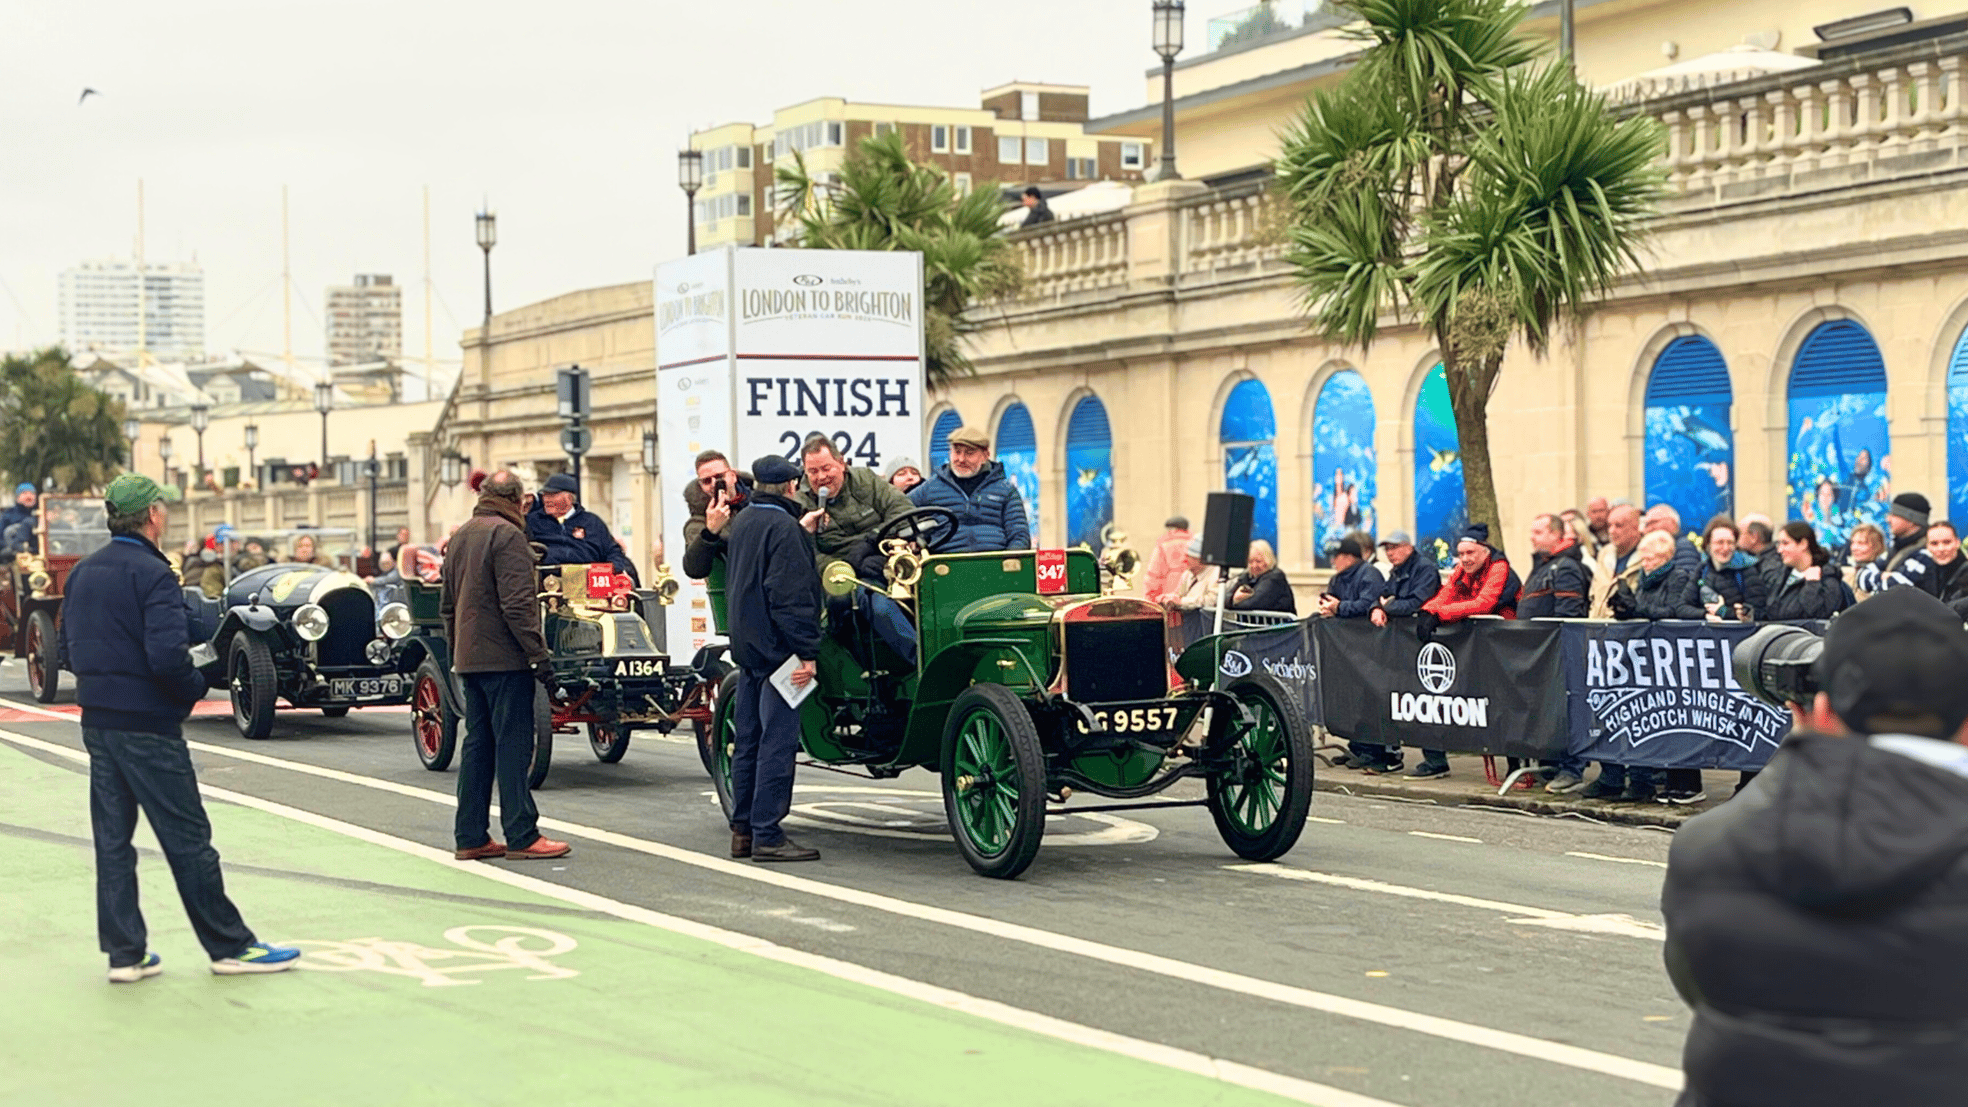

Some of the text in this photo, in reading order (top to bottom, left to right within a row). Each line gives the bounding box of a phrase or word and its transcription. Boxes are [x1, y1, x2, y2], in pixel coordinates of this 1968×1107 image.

[742, 289, 912, 321] LONDON TO BRIGHTON
[746, 377, 910, 417] FINISH
[779, 430, 881, 467] 224
[591, 575, 611, 588] 181
[1038, 564, 1065, 580] 347
[1262, 655, 1317, 684] Sotheby's
[334, 680, 399, 694] MK 9376
[1113, 707, 1178, 733] 9557
[1390, 692, 1488, 728] LOCKTON
[1605, 688, 1782, 738] HIGHLAND SINGLE MALT
[1631, 709, 1752, 741] SCOTCH WHISKY
